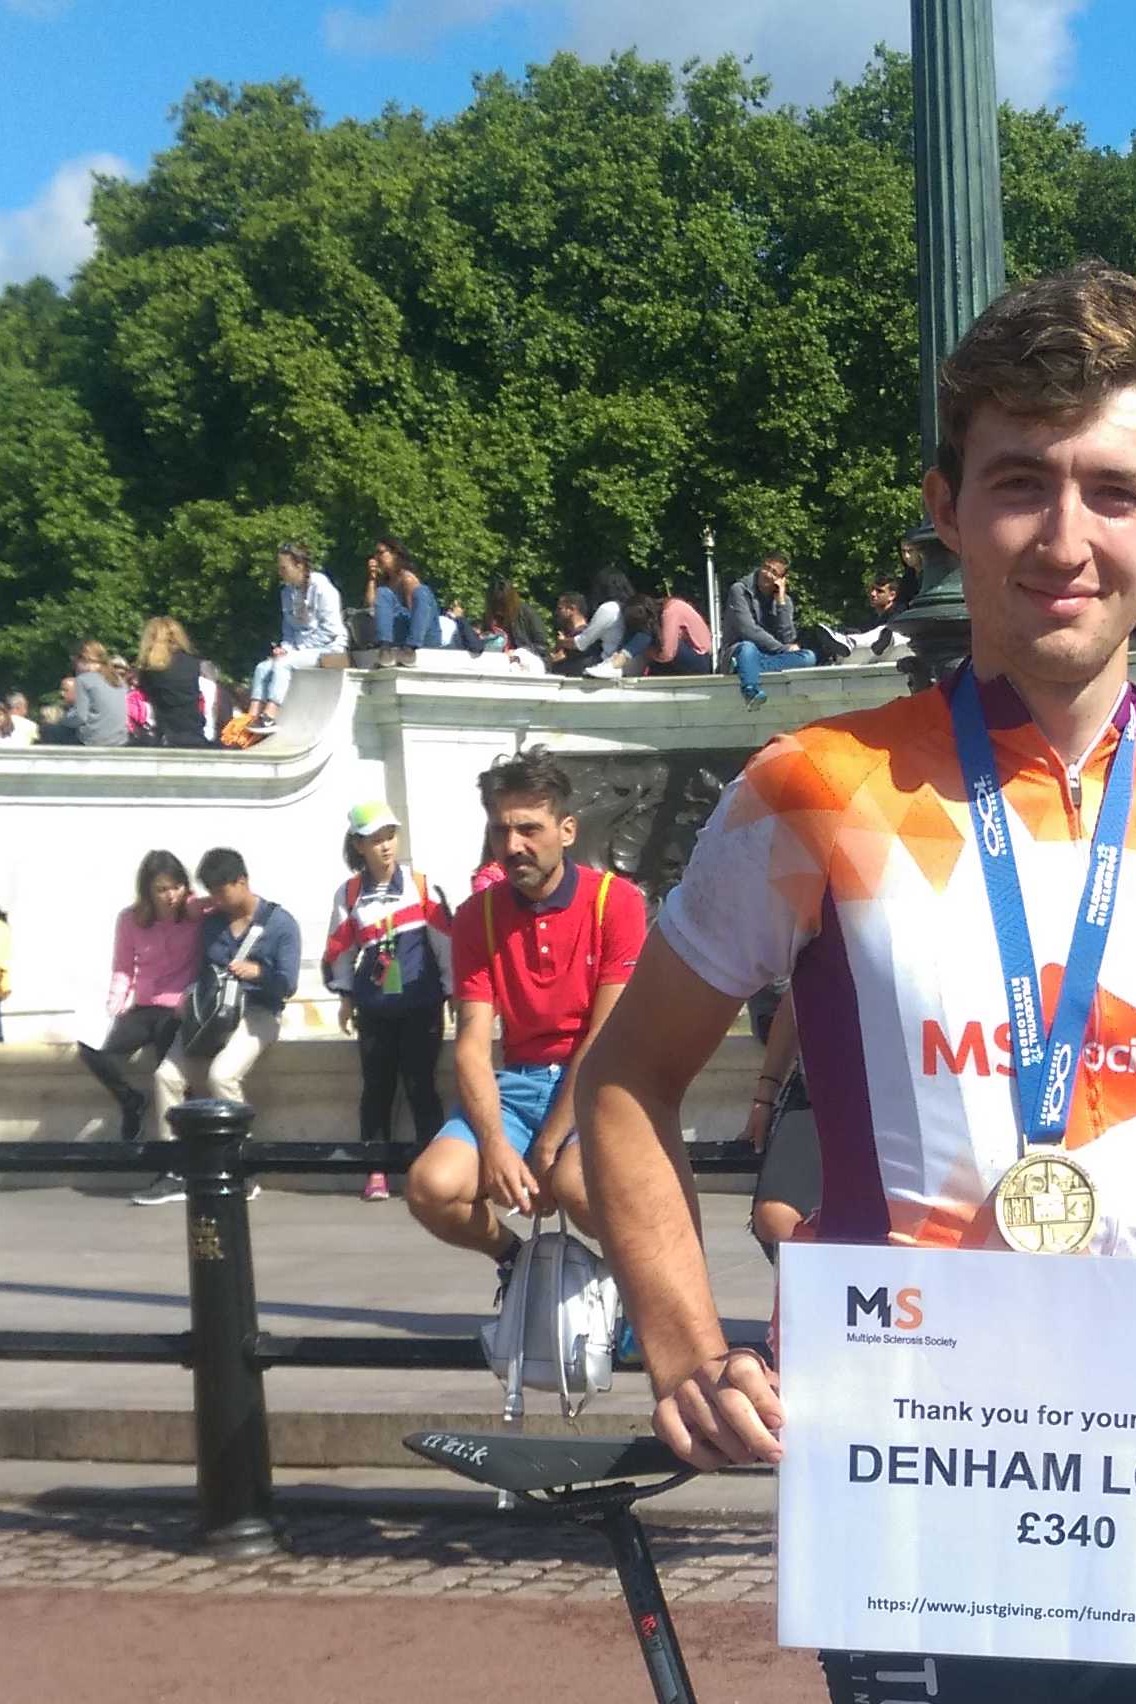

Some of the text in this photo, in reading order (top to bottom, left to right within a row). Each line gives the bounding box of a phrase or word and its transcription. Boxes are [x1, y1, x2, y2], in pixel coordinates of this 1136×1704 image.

[1011, 977, 1031, 1067] RIDELONDON
[1020, 976, 1039, 1047] PRUDENTIAL
[847, 1285, 923, 1330] MS
[846, 1332, 958, 1349] Multiple Sclerosis Society
[893, 1398, 973, 1423] Thank
[980, 1406, 1029, 1428] you
[1036, 1405, 1073, 1427] for
[848, 1443, 1082, 1493] DENHAM
[1016, 1511, 1117, 1549] £340
